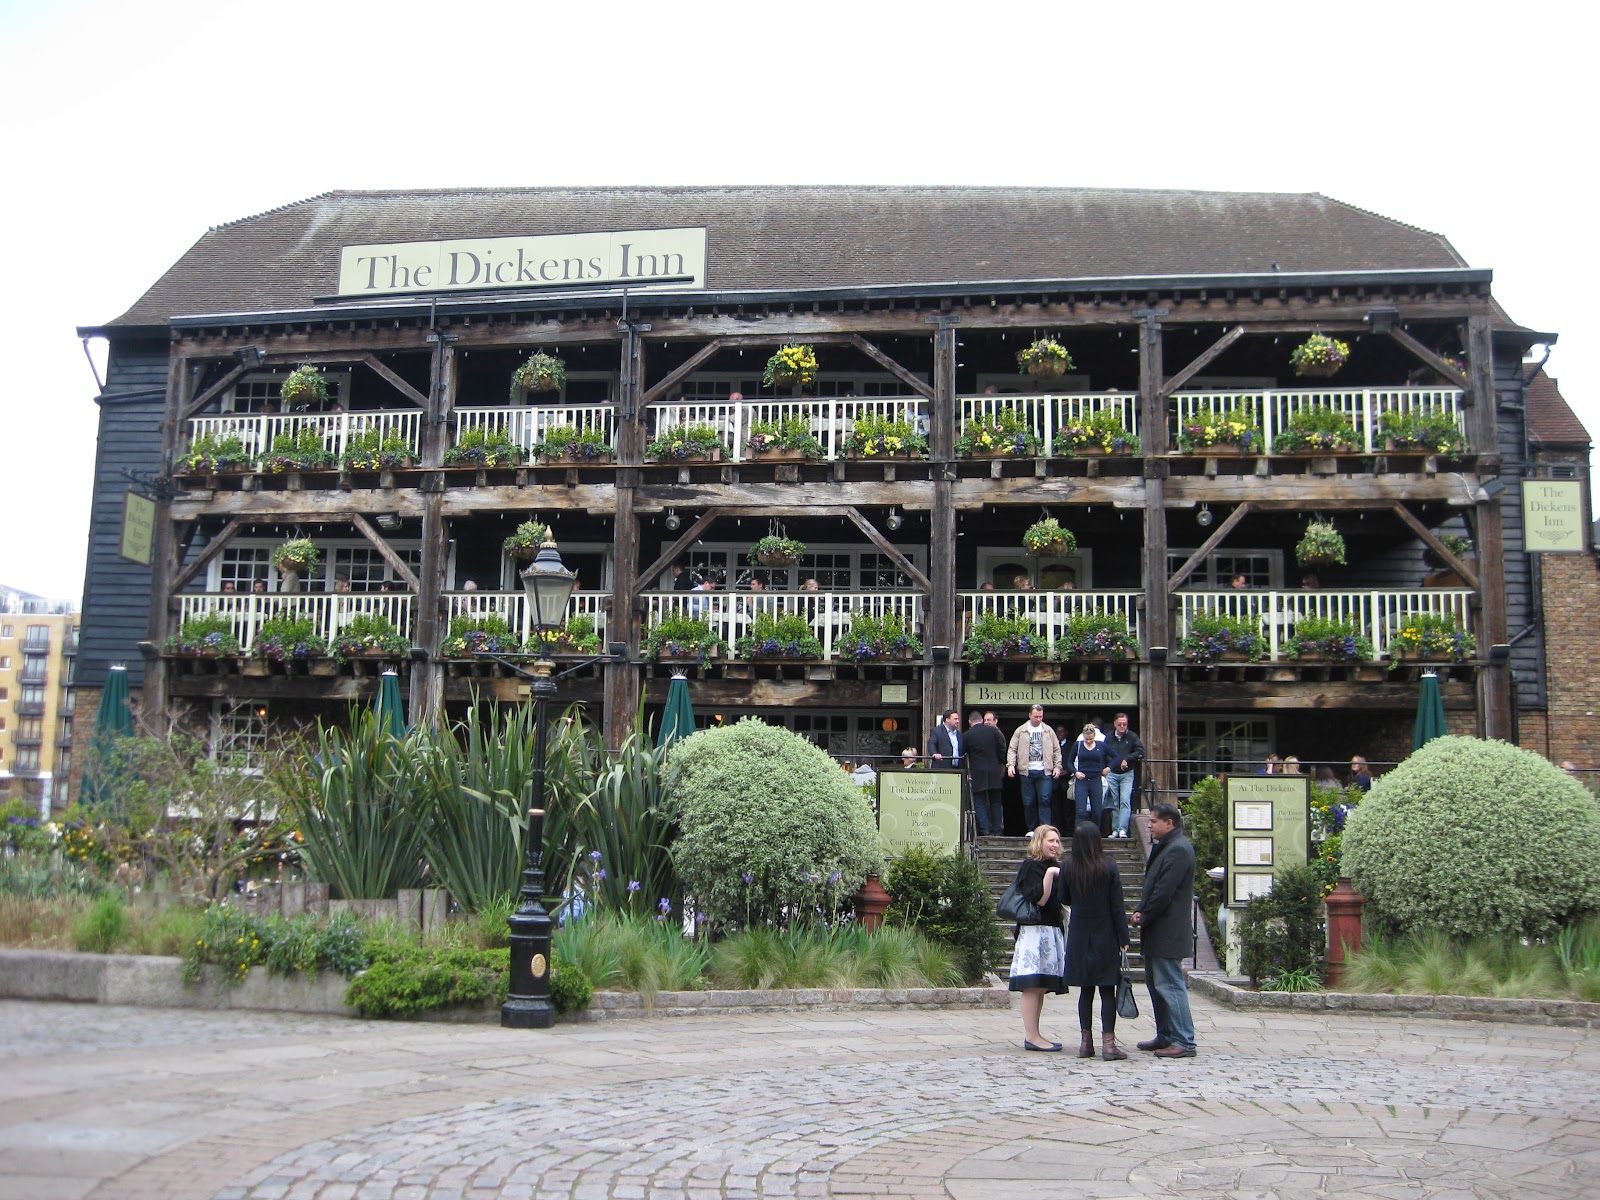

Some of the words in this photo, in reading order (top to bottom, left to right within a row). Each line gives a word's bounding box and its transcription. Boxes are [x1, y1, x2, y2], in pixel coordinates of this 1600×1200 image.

[357, 254, 433, 290] The
[447, 248, 602, 285] Dickens
[618, 243, 686, 278] Inn
[1540, 486, 1564, 498] The
[1530, 501, 1576, 512] Dickens
[1544, 515, 1564, 526] Inn
[979, 687, 1004, 700] Bar
[1008, 687, 1034, 700] and
[1040, 687, 1121, 700] Restaurants
[890, 785, 905, 794] The
[907, 786, 937, 795] Dickens
[939, 787, 952, 795] Inn
[1248, 784, 1263, 792] The
[1266, 784, 1296, 792] Dickens
[920, 810, 936, 818] Grill
[908, 829, 932, 837] Tavern
